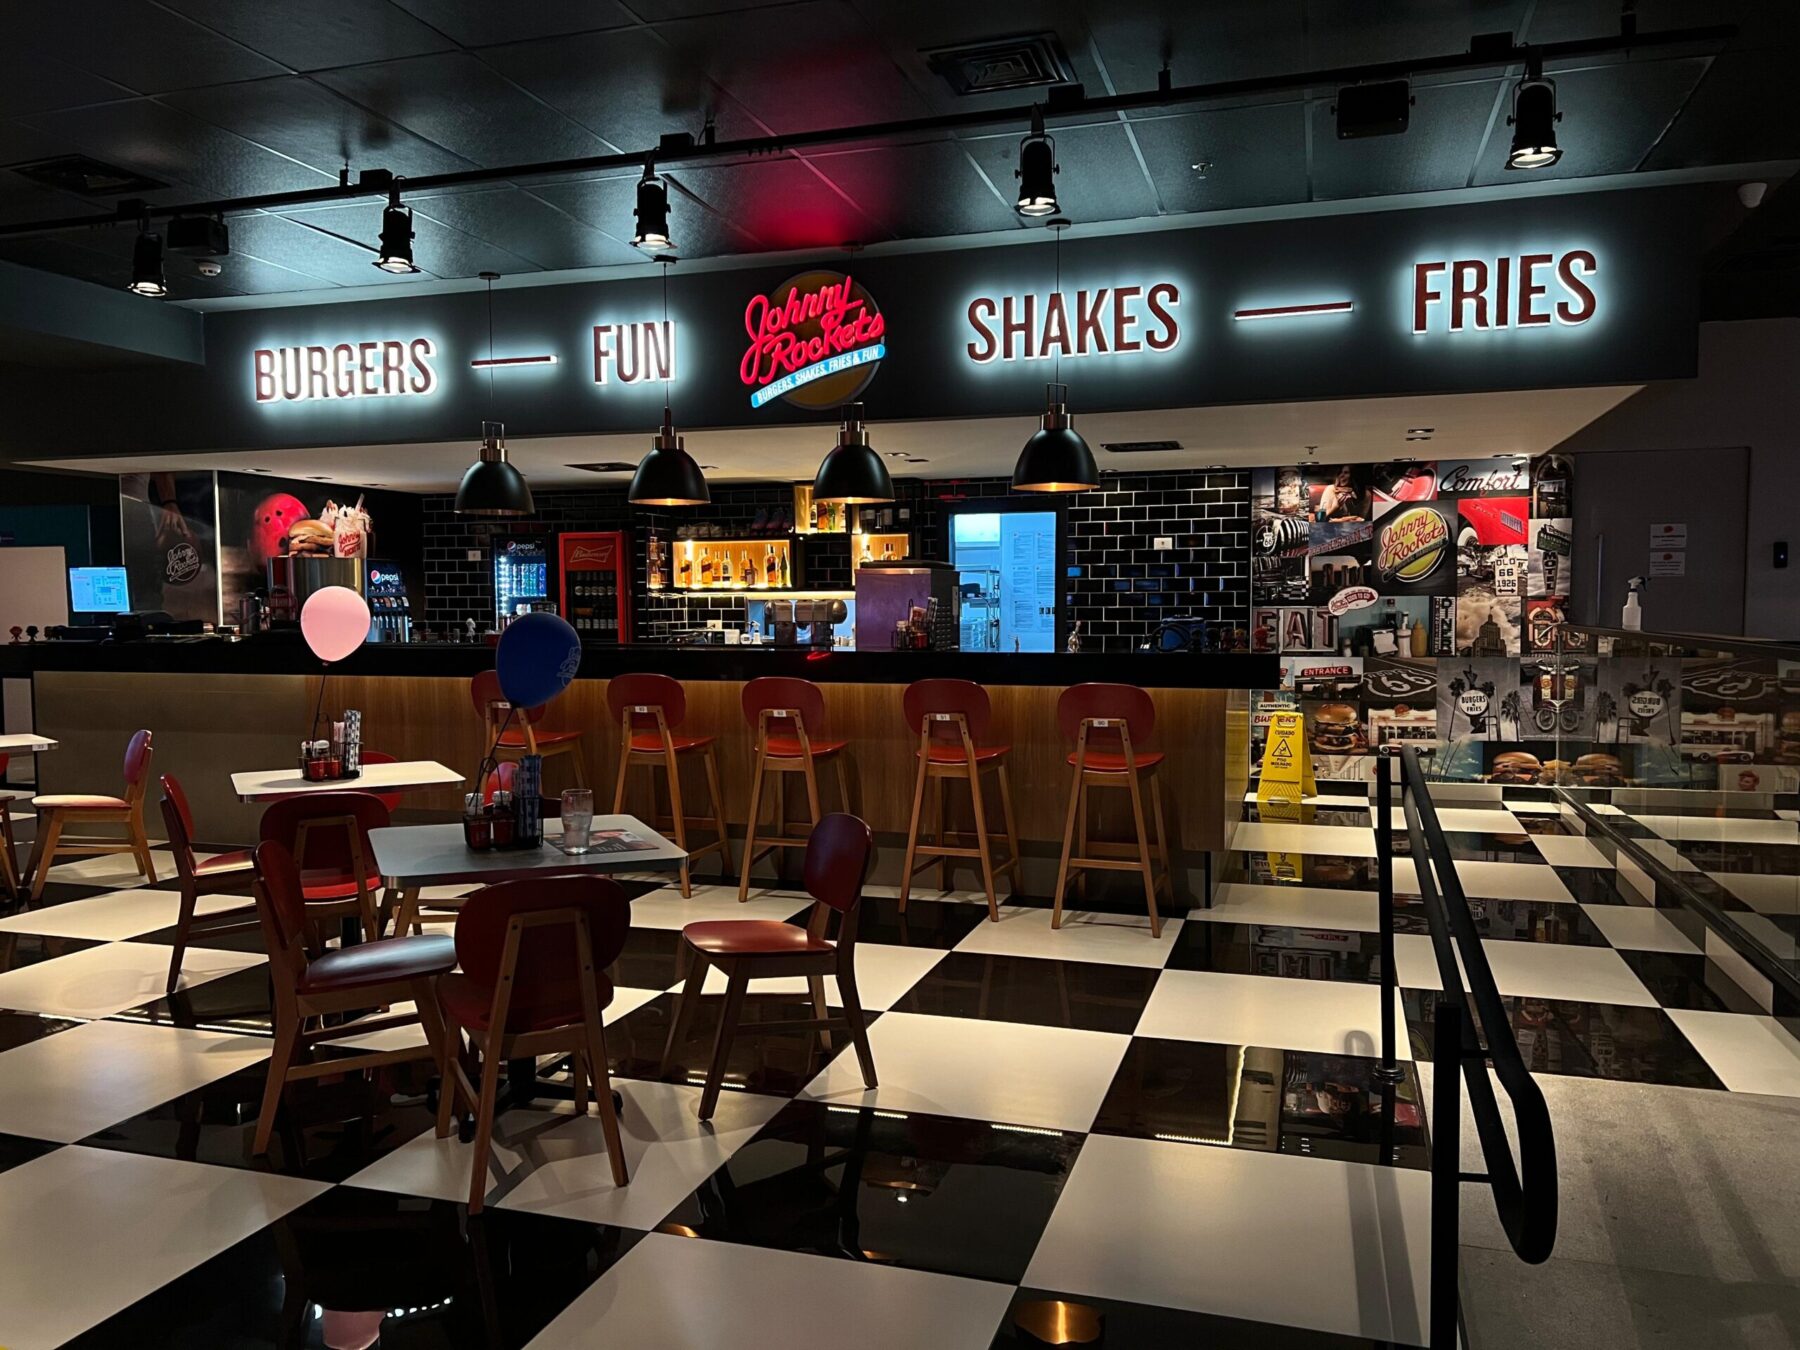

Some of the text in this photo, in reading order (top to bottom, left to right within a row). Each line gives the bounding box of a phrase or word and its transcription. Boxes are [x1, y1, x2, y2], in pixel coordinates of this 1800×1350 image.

[1412, 249, 1597, 335] FRIES
[740, 275, 864, 385] Johnny
[966, 283, 1182, 363] SHAKES
[593, 319, 676, 385] FUN
[758, 306, 885, 384] Rockets
[861, 347, 879, 362] FUN
[254, 337, 438, 403] BURGERS
[1439, 465, 1523, 497] Comfort
[516, 542, 535, 551] pepsi
[1379, 511, 1434, 569] Johnny
[1386, 522, 1446, 570] Rockets
[381, 573, 400, 583] pepsi
[1496, 579, 1516, 588] 1926
[1499, 568, 1514, 577] 66
[1543, 551, 1557, 591] MOTEL
[1255, 610, 1336, 650] EAT
[1441, 598, 1453, 650] DINER
[1302, 667, 1349, 676] ENTRANCE
[1381, 673, 1432, 692] 66
[1461, 695, 1486, 704] BURGERS
